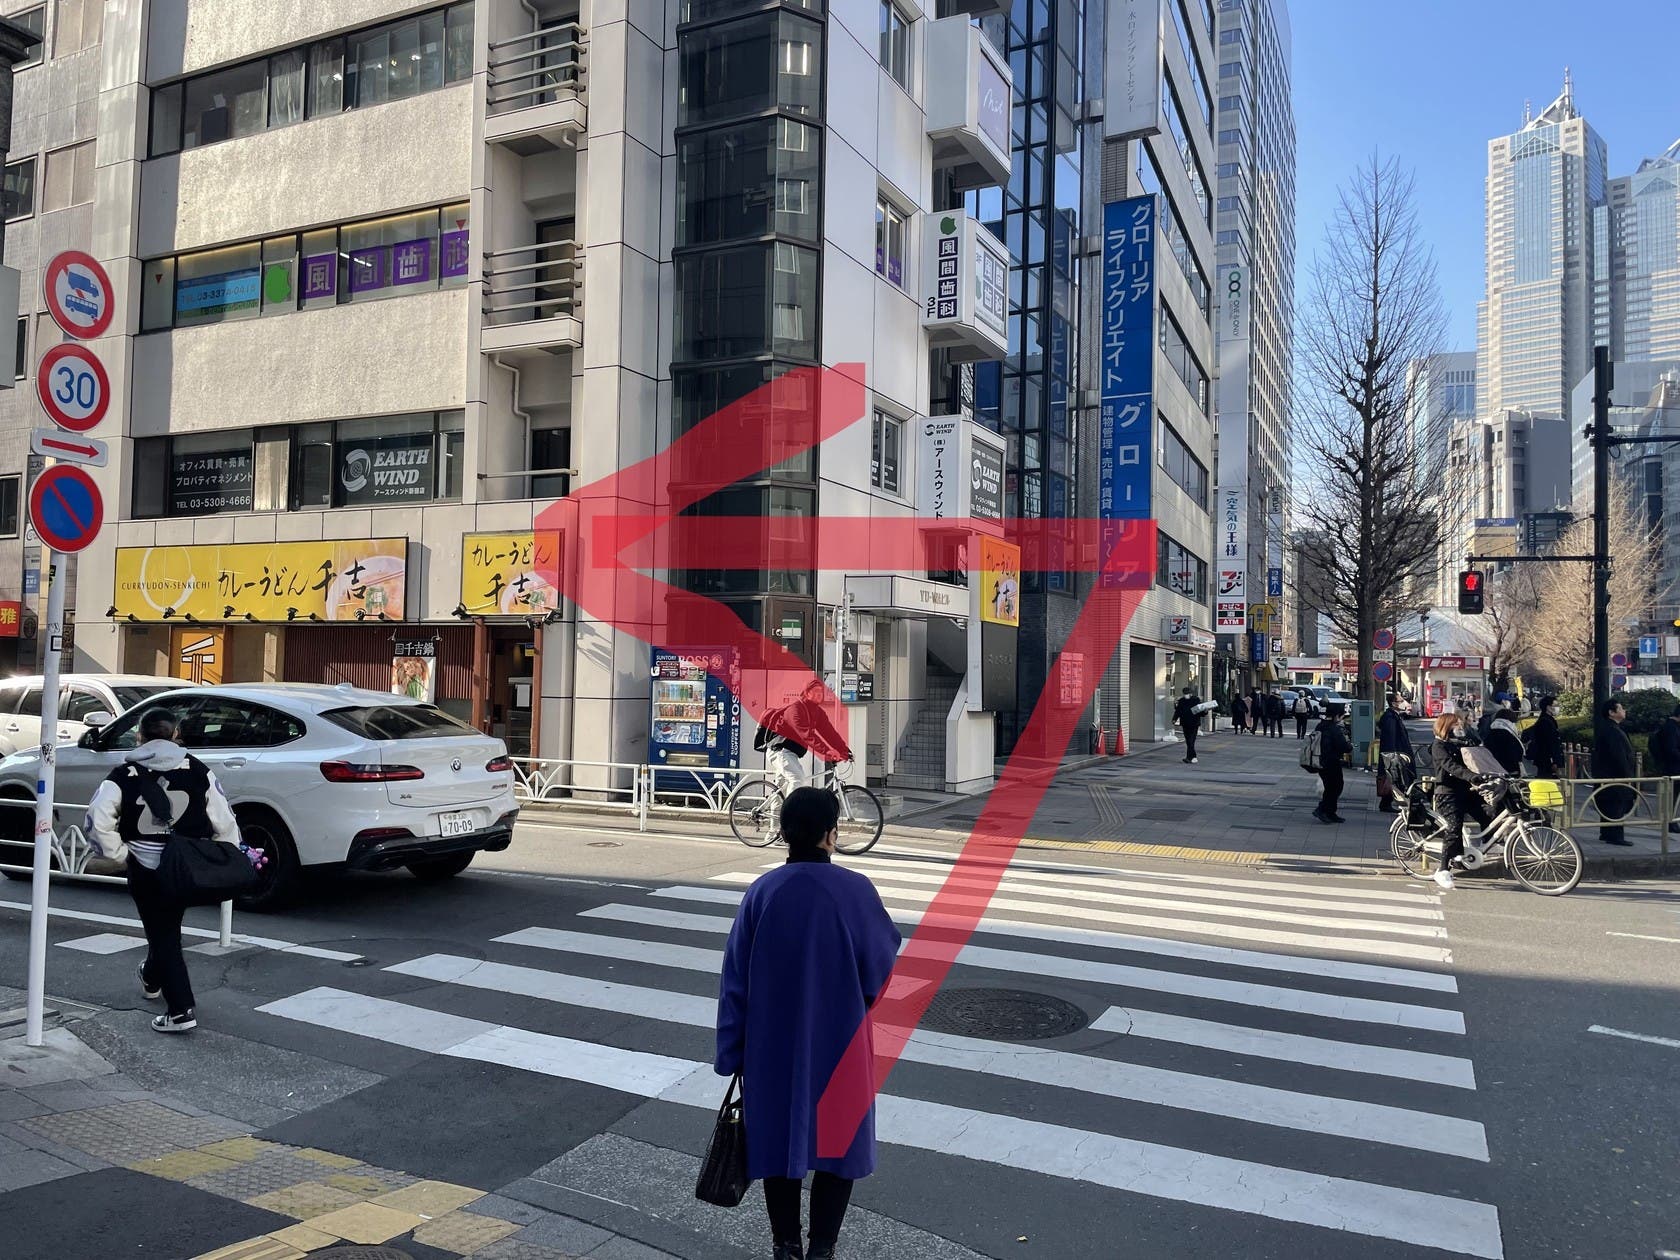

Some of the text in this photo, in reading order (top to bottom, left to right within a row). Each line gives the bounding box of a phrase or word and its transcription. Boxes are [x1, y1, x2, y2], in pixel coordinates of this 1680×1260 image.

[1130, 203, 1152, 303] グローリア
[940, 239, 957, 317] 風間歯科
[927, 296, 936, 318] 3F
[1105, 228, 1126, 390] ライフクリエイト
[55, 366, 96, 409] 30
[373, 448, 431, 468] EARTH
[373, 469, 420, 486] WIND
[982, 465, 1001, 483] EARTH
[982, 479, 998, 494] WIND
[176, 495, 251, 509] TEL 03-5308-4666
[1118, 401, 1146, 583] グローリア
[1226, 497, 1238, 557] 空気の王様
[471, 541, 553, 567] カレーうどん
[986, 552, 1016, 578] カレーうどん
[121, 580, 211, 591] CURRYUDON-SENKICHI
[483, 571, 532, 606] 千吉
[991, 579, 1011, 618] 千吉
[1, 608, 17, 625] 雅
[448, 819, 473, 834] 70-09
